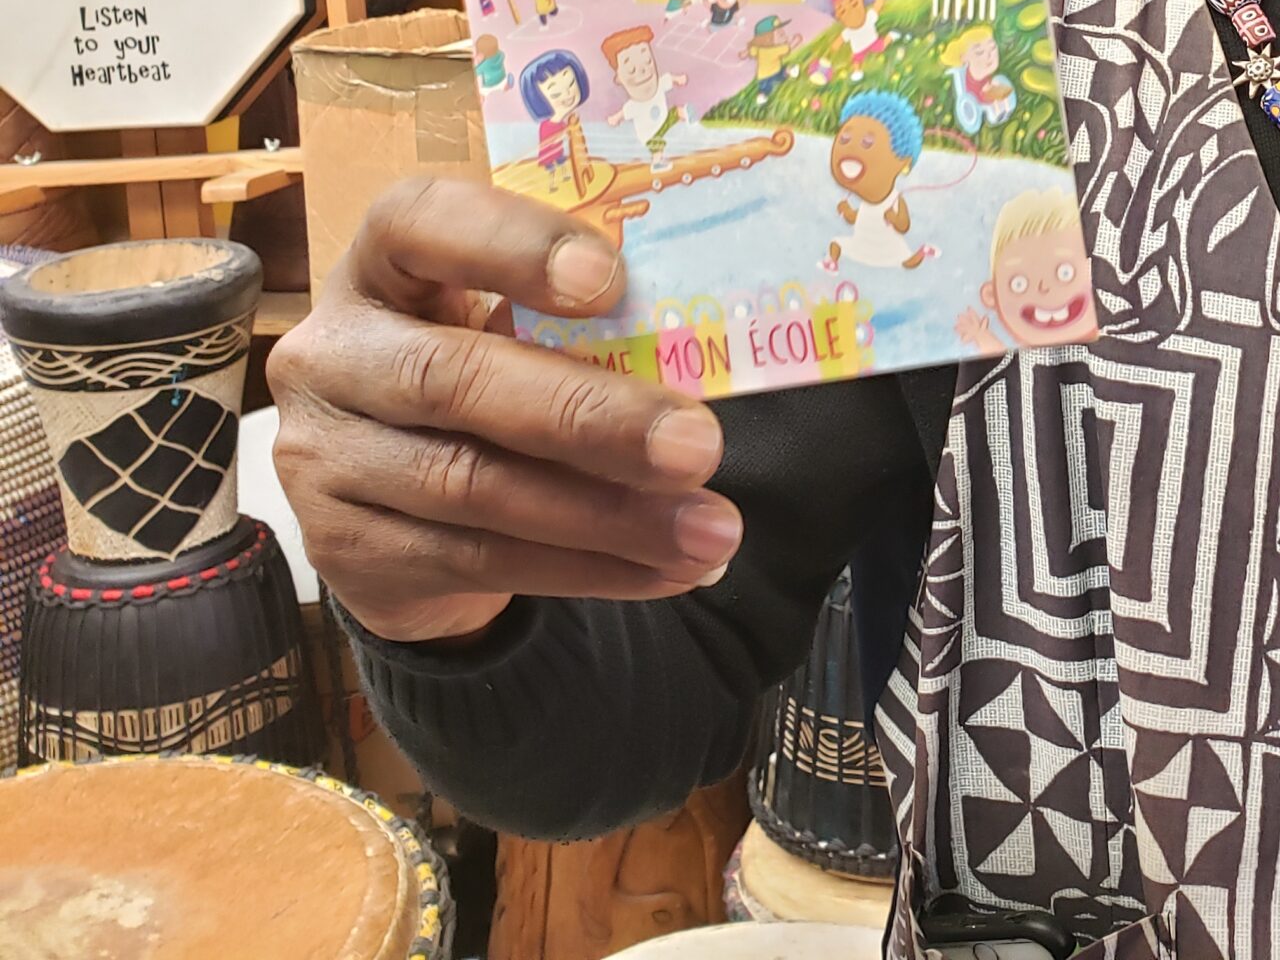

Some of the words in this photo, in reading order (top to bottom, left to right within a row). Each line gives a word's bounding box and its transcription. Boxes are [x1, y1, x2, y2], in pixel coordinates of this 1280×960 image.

[74, 36, 98, 55] to
[114, 35, 160, 60] your
[71, 60, 171, 87] Heartbeat
[655, 334, 731, 383] MON
[750, 316, 844, 368] ÉCOLE
